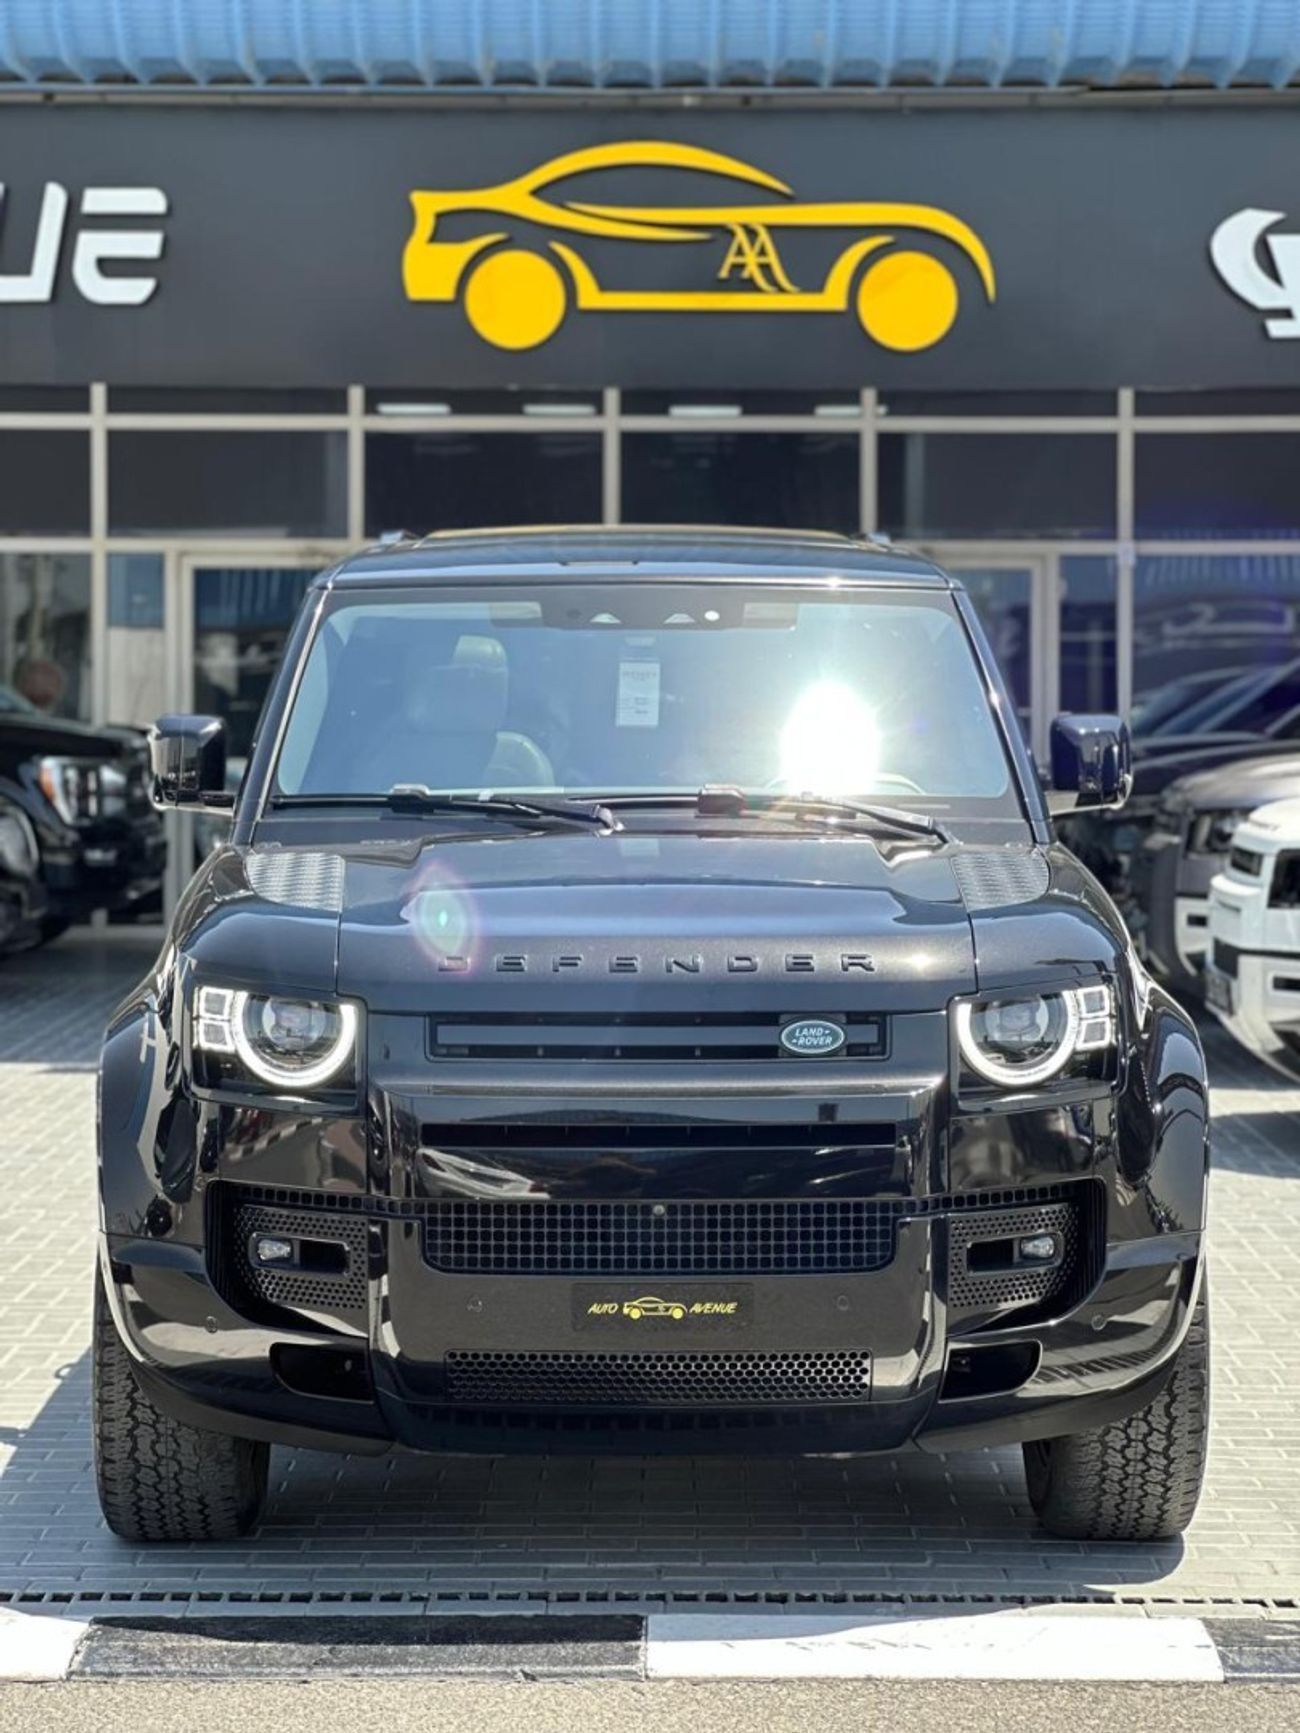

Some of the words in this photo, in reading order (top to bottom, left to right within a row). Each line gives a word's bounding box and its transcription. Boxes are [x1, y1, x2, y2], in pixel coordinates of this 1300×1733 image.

[437, 954, 876, 973] DEFENDER
[587, 1302, 619, 1315] AUTO
[689, 1302, 738, 1314] AVENUE
